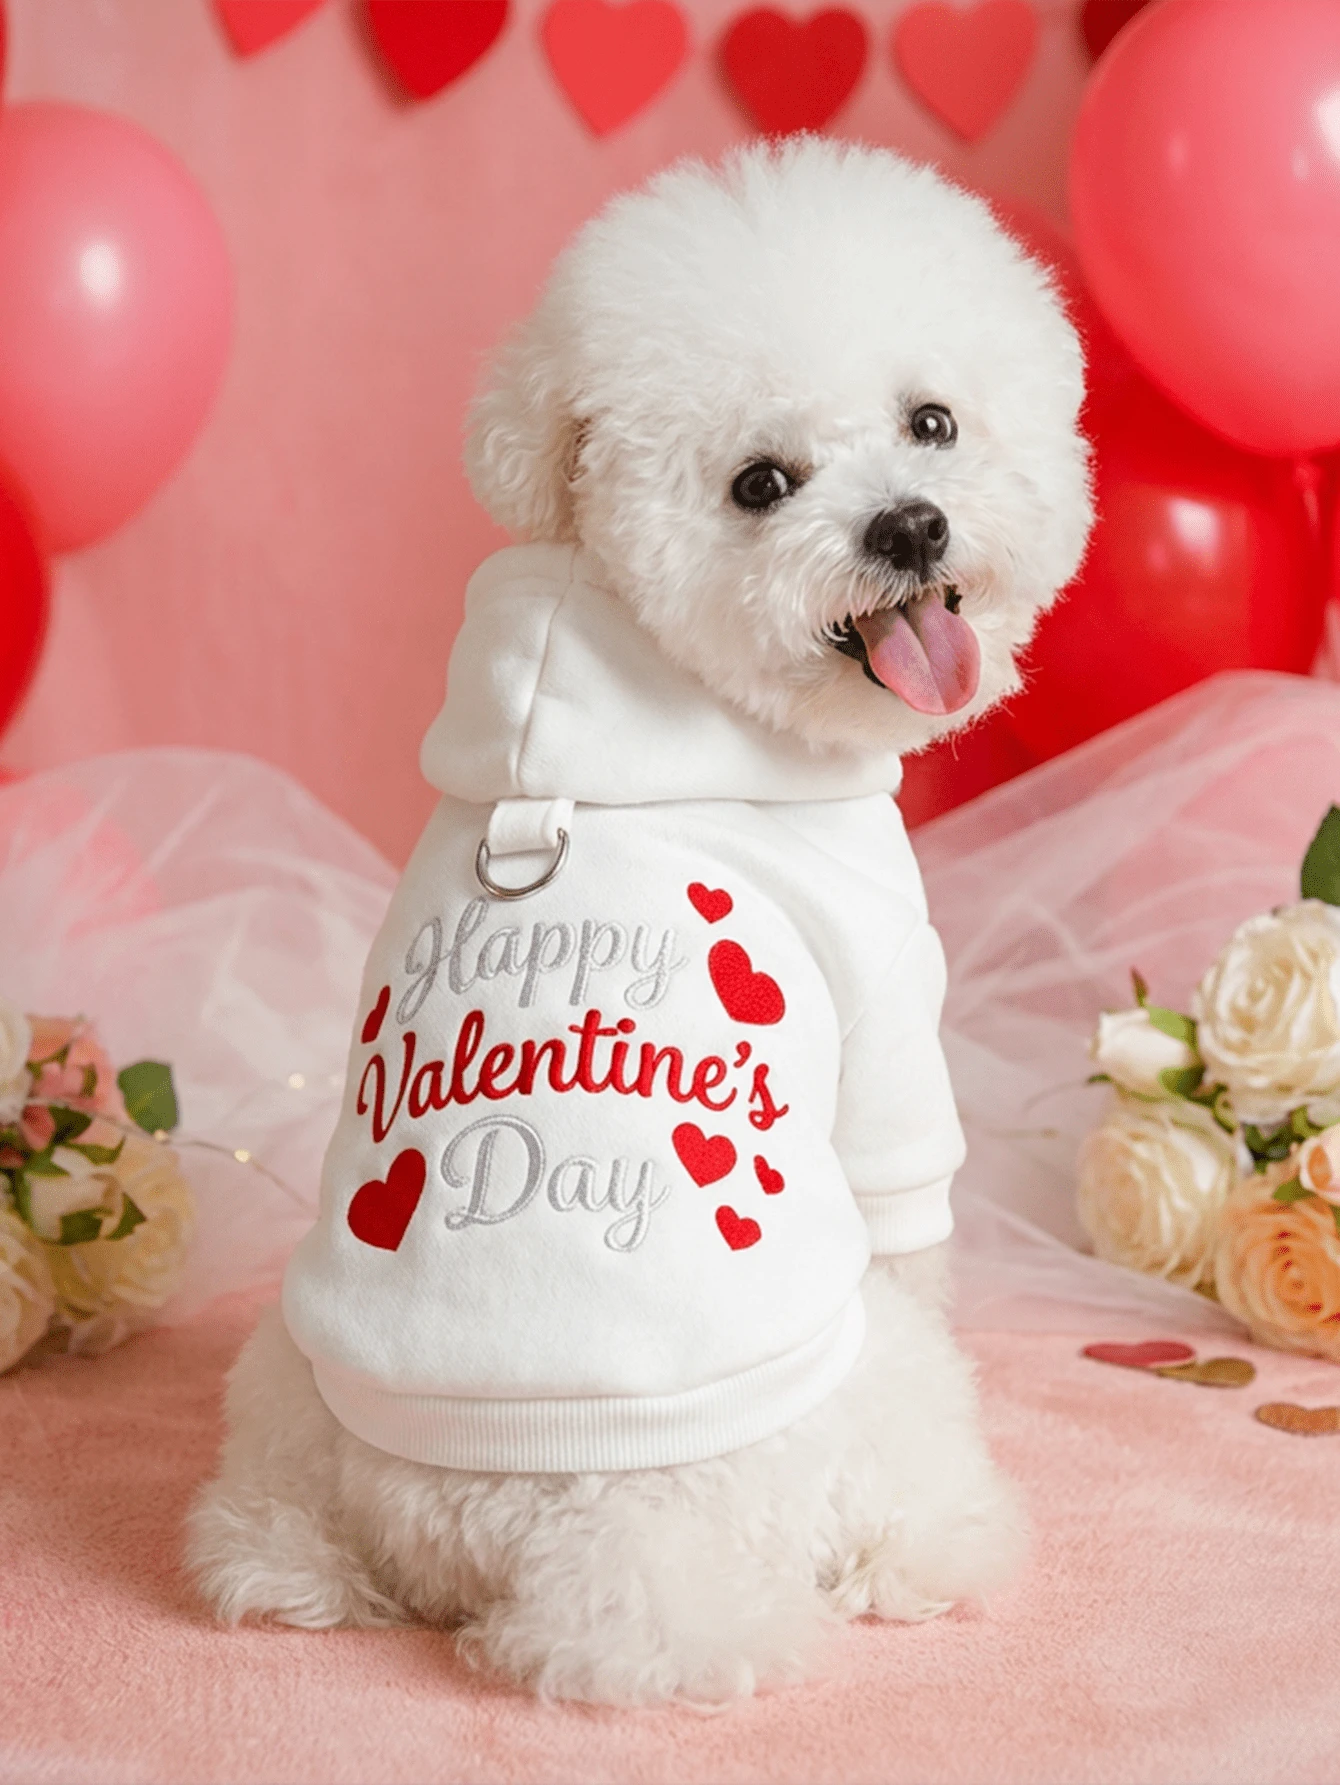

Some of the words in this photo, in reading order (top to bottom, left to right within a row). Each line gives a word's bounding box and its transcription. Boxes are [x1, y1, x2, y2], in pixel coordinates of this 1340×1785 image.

[396, 896, 689, 1024] Happy
[356, 1009, 790, 1143] Valentine's
[440, 1113, 671, 1253] Day
